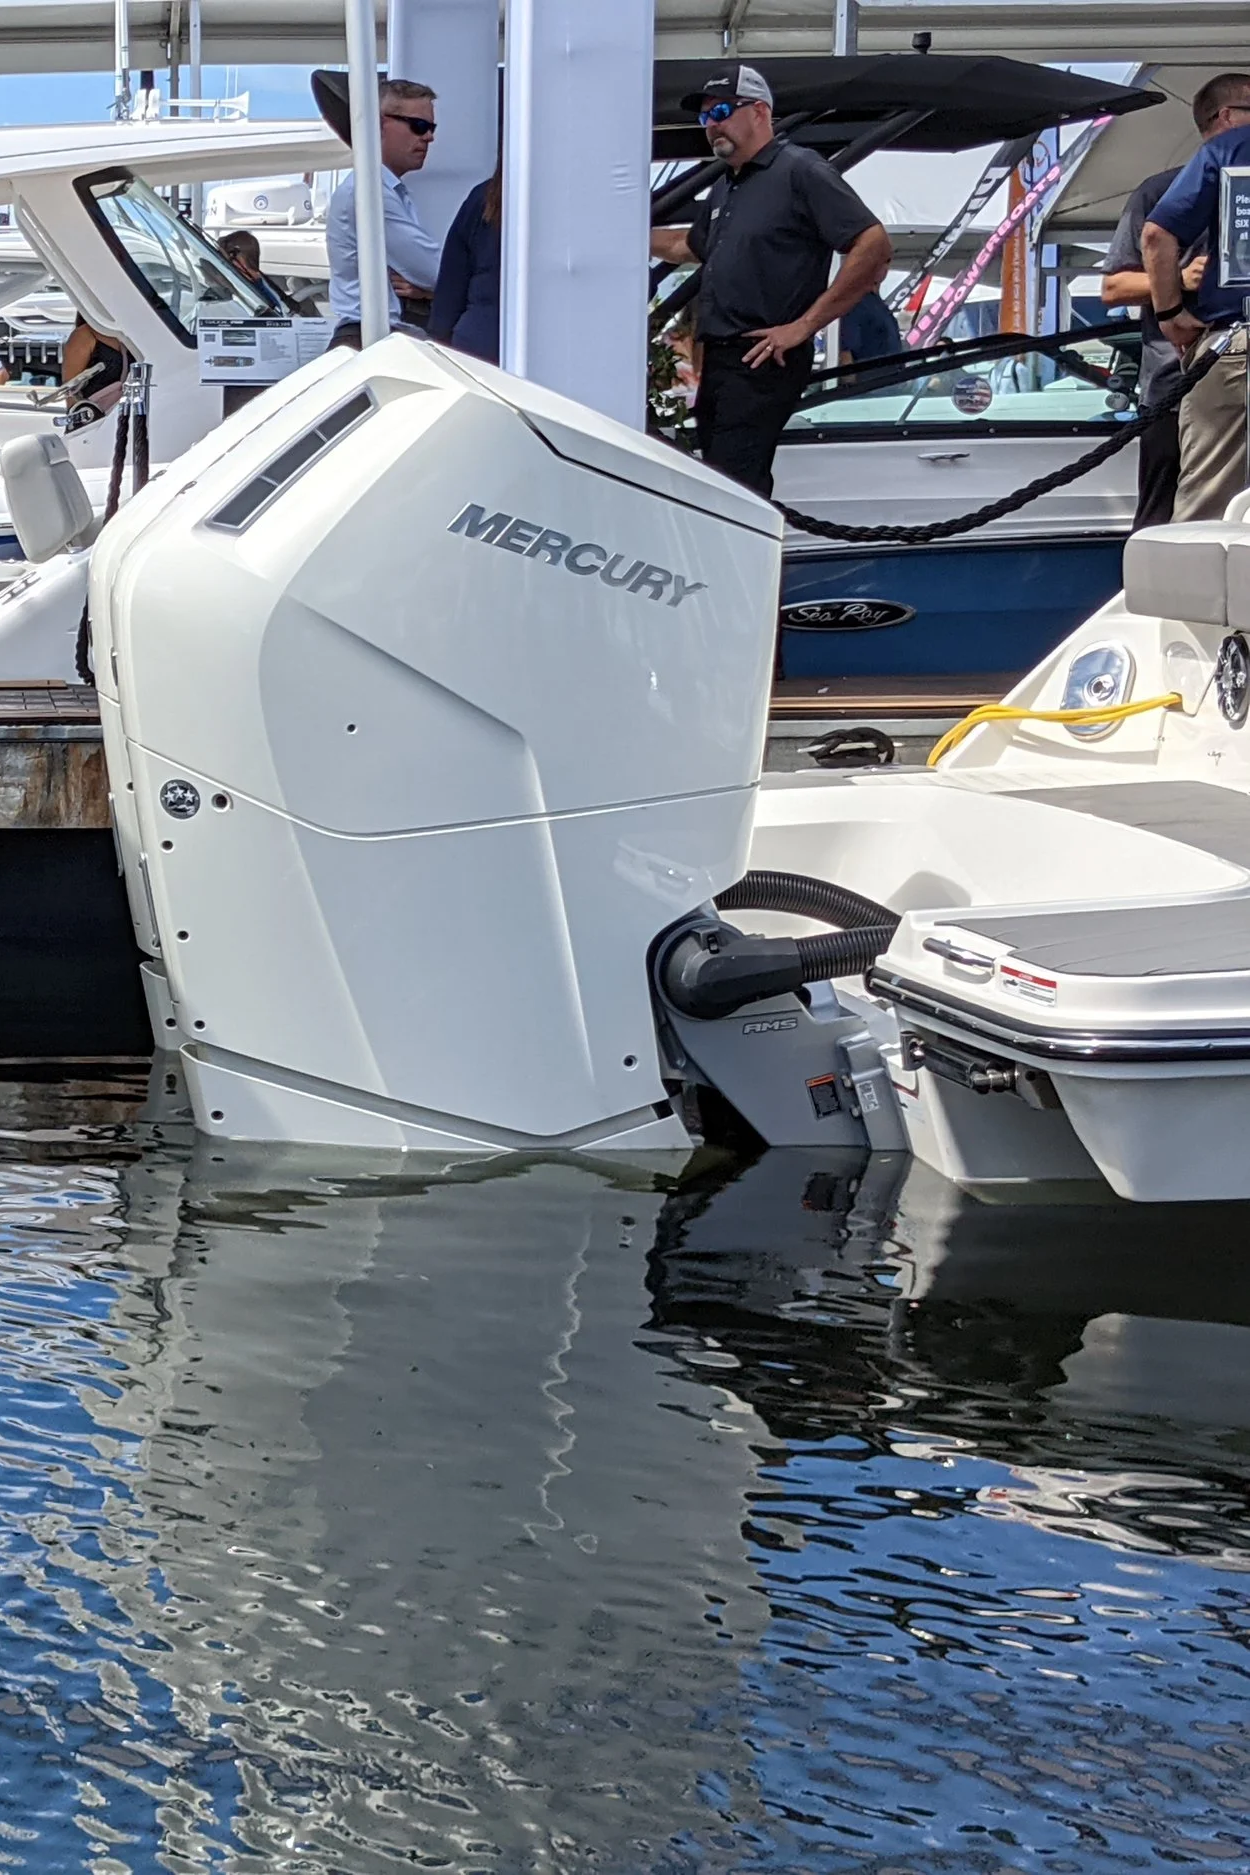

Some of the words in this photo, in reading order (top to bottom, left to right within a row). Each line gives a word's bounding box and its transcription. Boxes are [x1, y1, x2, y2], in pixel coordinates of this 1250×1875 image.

[1235, 195, 1250, 204] Ple
[1235, 219, 1249, 228] SIX
[447, 502, 708, 608] MERCURY
[788, 606, 836, 622] Sea
[838, 603, 889, 625] Ray
[742, 1018, 798, 1035] AMS
